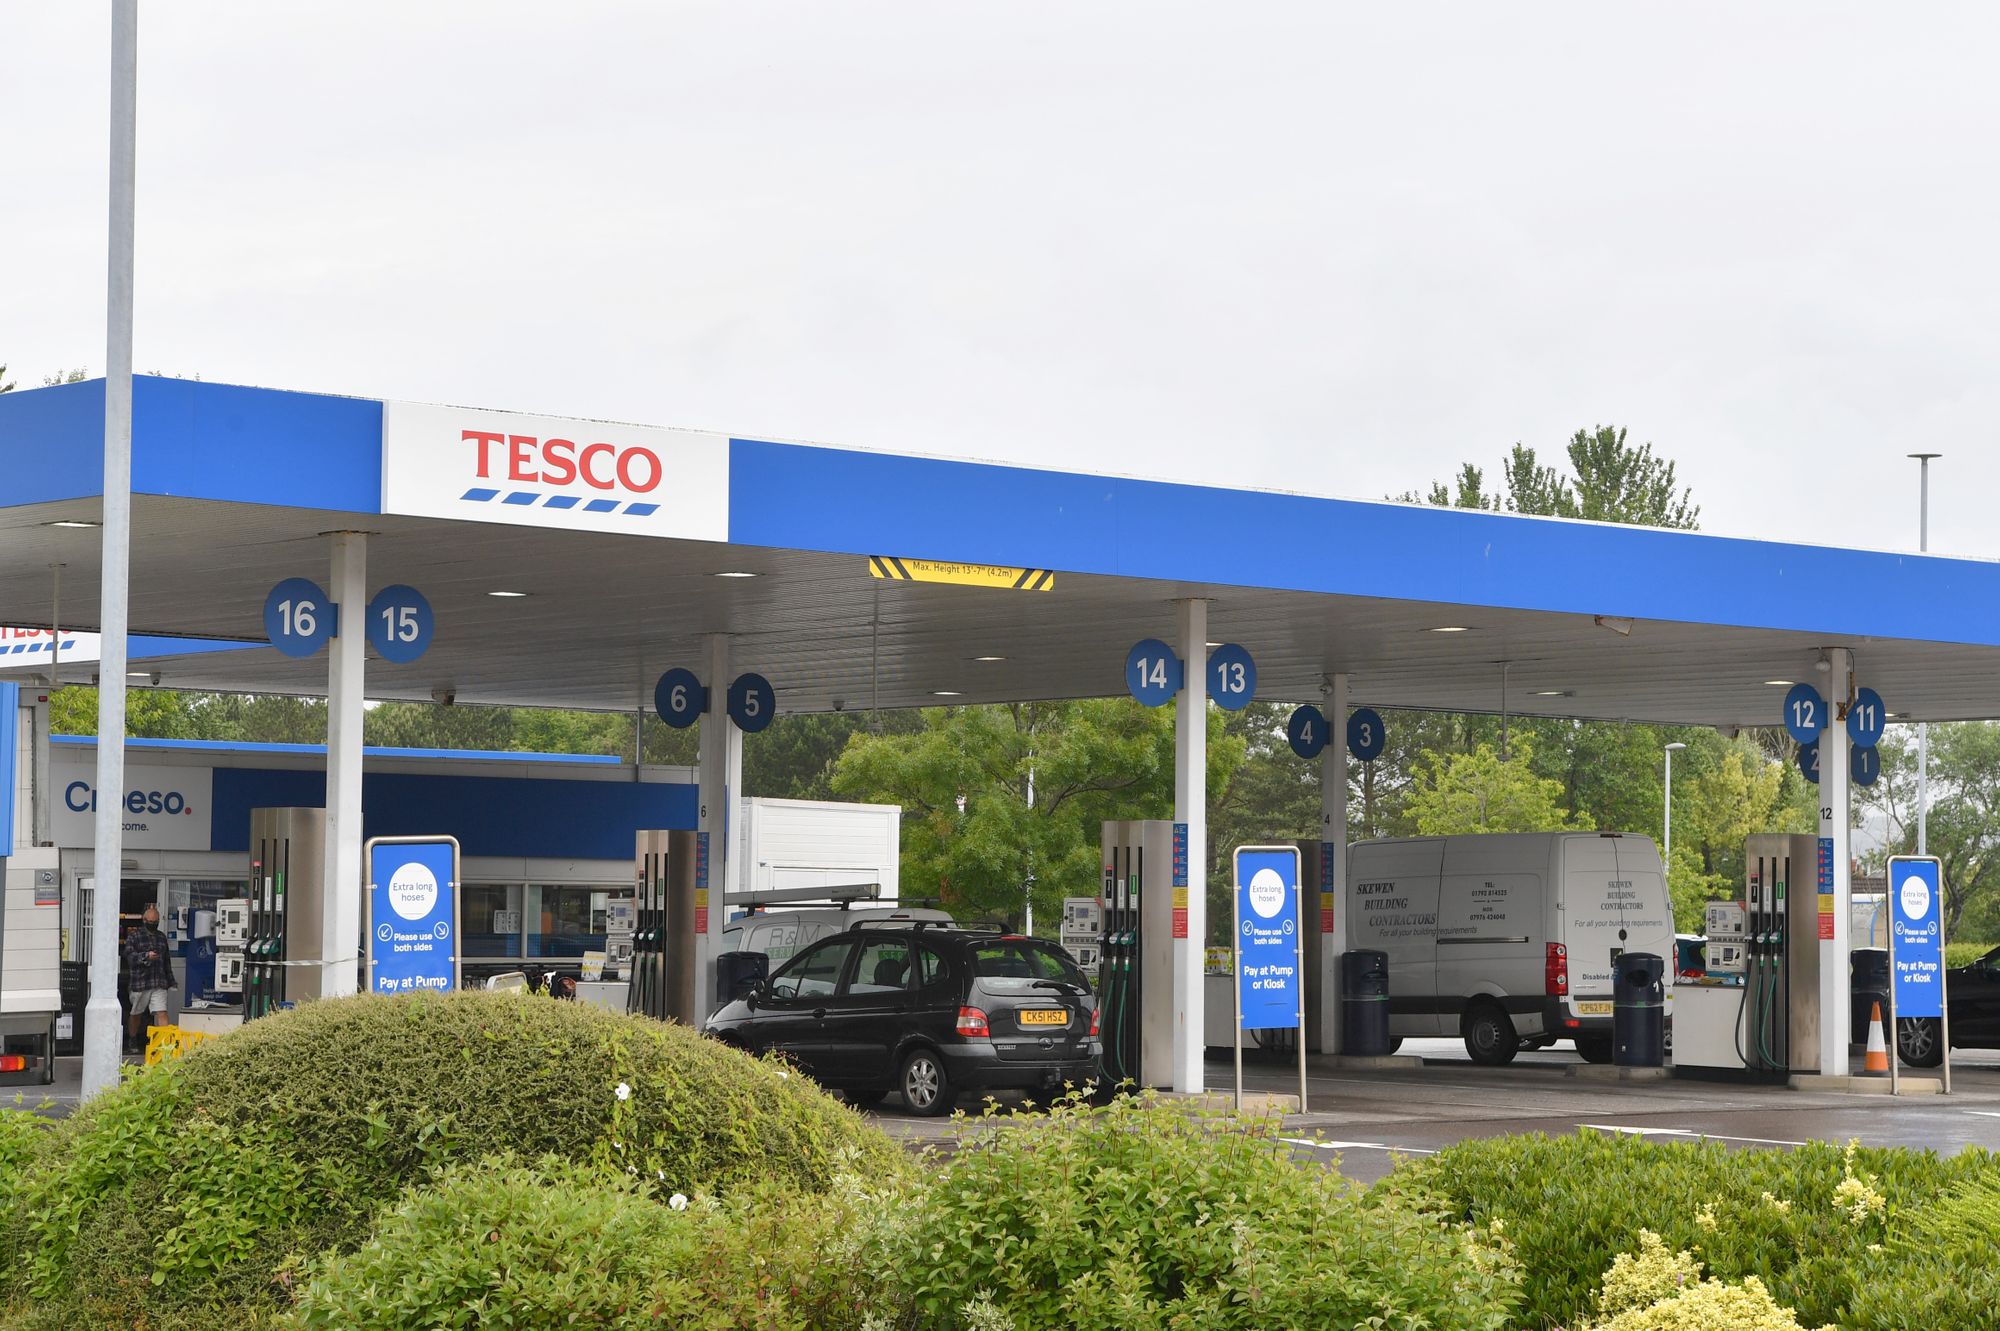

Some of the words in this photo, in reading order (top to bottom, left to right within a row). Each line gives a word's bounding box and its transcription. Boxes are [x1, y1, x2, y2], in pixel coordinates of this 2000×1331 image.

[461, 429, 662, 494] TESCO
[912, 561, 932, 572] Max.
[934, 563, 960, 576] Height
[987, 568, 1013, 579] (4.2m)
[278, 600, 316, 637] 16
[382, 606, 419, 642] 15
[1136, 657, 1167, 689] 14
[1218, 662, 1246, 694] 13
[670, 684, 687, 713] 6
[745, 689, 760, 717] 5
[1792, 700, 1815, 728] 12
[1856, 704, 1875, 732] 11
[1300, 720, 1313, 745] 4
[1359, 723, 1372, 747] 3
[1810, 748, 1819, 771] 2
[1861, 751, 1868, 774] 1
[700, 805, 707, 818] 6
[1820, 807, 1833, 820] 12
[1324, 814, 1331, 825] 4
[393, 882, 414, 892] Extra
[416, 882, 433, 892] long
[1252, 885, 1268, 893] Extra
[1269, 885, 1282, 894] long
[1356, 882, 1396, 895] SKEWEN
[1607, 880, 1632, 889] SKEWEN
[401, 893, 425, 902] hoses
[1258, 894, 1276, 902] hoses
[1607, 891, 1636, 900] BUILDING
[1916, 890, 1927, 899] long
[1364, 897, 1408, 911] BUILDING
[1600, 902, 1644, 911] CONTRACTORS
[1369, 913, 1437, 927] CONTRACTORS
[1574, 919, 1585, 928] For
[1586, 919, 1594, 927] all
[1594, 920, 1608, 928] your
[1609, 919, 1630, 928] building
[1631, 919, 1663, 928] requirements
[394, 932, 418, 941] Please
[419, 933, 433, 941] use
[1254, 928, 1271, 936] Please
[1379, 928, 1390, 937] For
[1413, 927, 1437, 937] building
[1440, 926, 1478, 936] requirements
[394, 943, 412, 952] both
[413, 943, 433, 952] sides
[1254, 937, 1267, 945] both
[1268, 937, 1283, 945] sides
[1244, 965, 1258, 978] Pay
[1260, 965, 1268, 975] at
[1270, 964, 1294, 977] Pump
[1897, 961, 1908, 972] Pay
[1909, 962, 1917, 970] at
[1918, 961, 1938, 972] Pump
[380, 976, 399, 991] Pay
[401, 976, 413, 988] at
[415, 975, 448, 989] Pump
[1252, 980, 1262, 989] or
[1263, 978, 1286, 989] Kiosk
[1904, 974, 1912, 983] or
[1913, 973, 1931, 983] Kiosk
[1026, 1012, 1046, 1022] CK51
[1047, 1012, 1063, 1022] HSZ
